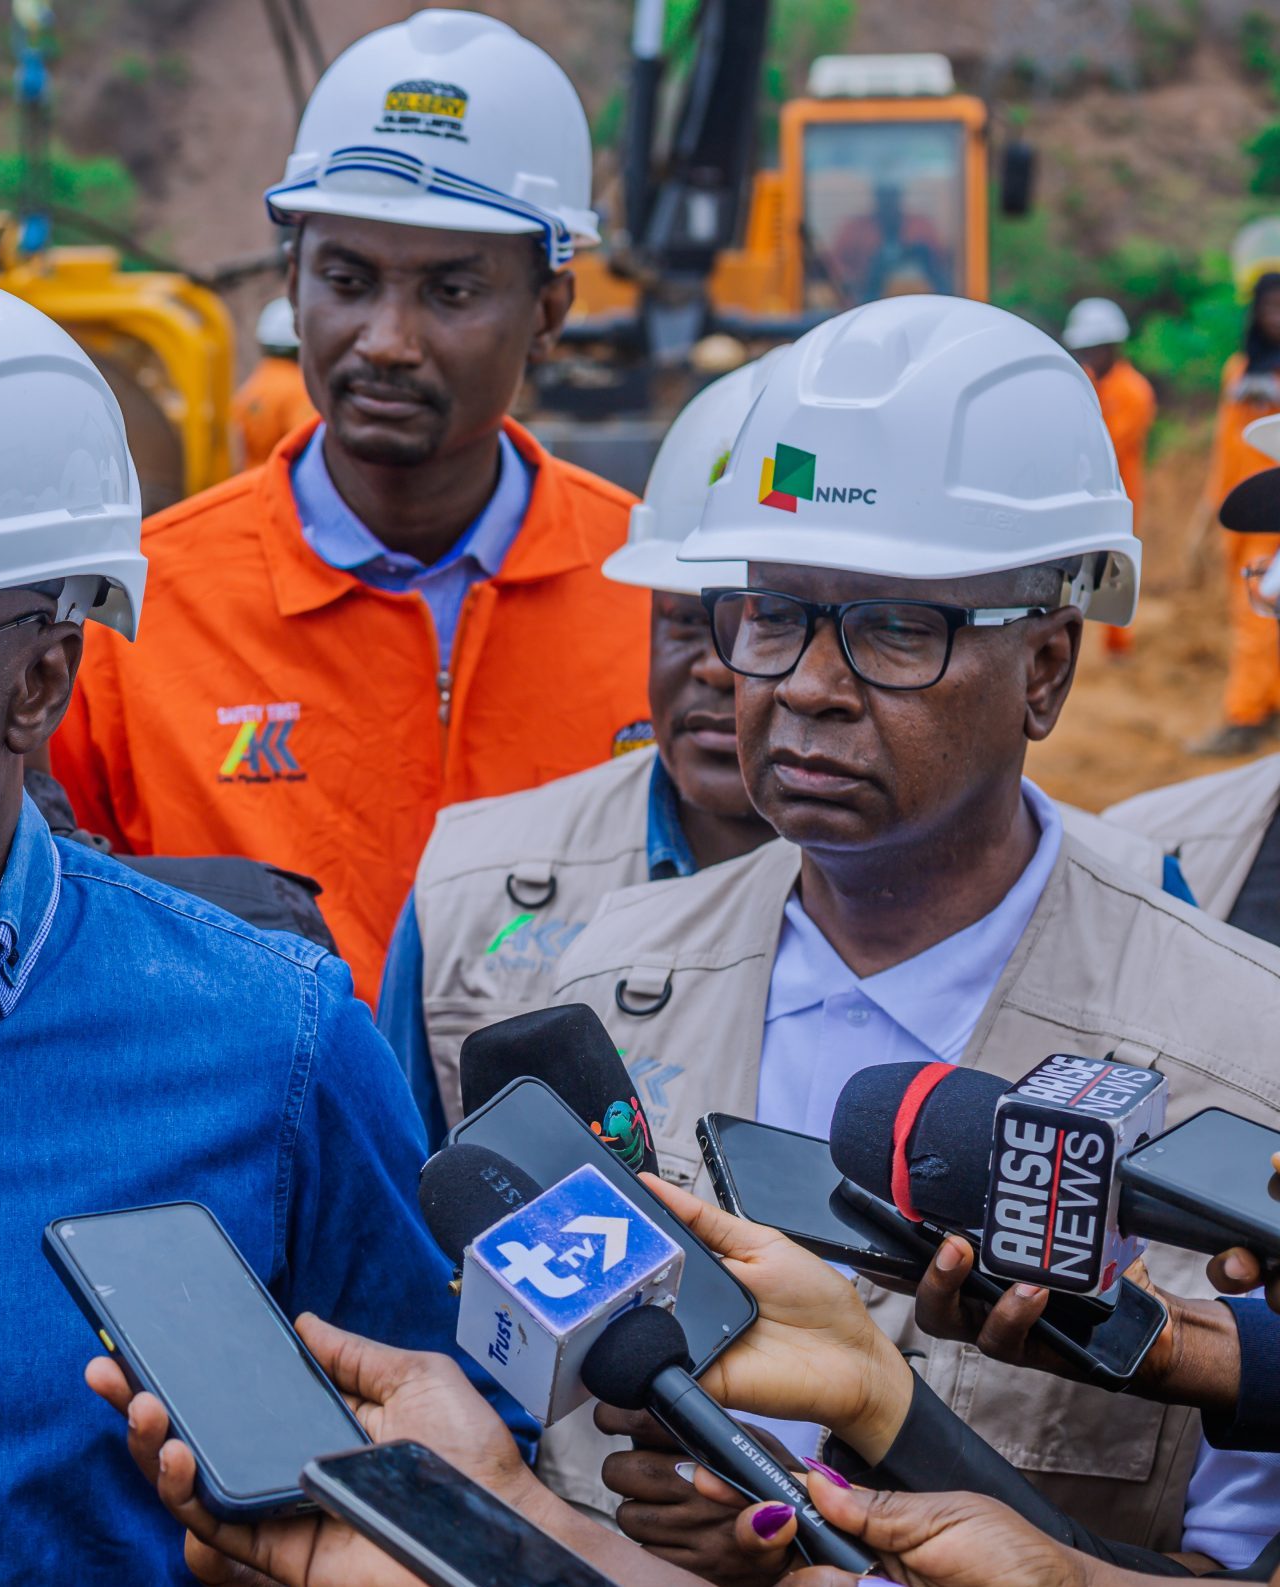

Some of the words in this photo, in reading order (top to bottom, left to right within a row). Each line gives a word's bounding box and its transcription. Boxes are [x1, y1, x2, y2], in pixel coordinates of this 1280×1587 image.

[815, 486, 878, 505] NNPC
[1017, 1055, 1105, 1106] ARISE
[1072, 1067, 1153, 1116] NEWS
[990, 1118, 1057, 1268] ARISE
[1050, 1130, 1105, 1281] NEWS
[558, 1238, 596, 1269] TV
[488, 1311, 513, 1366] Trust
[731, 1433, 806, 1503] SENNHEISER
